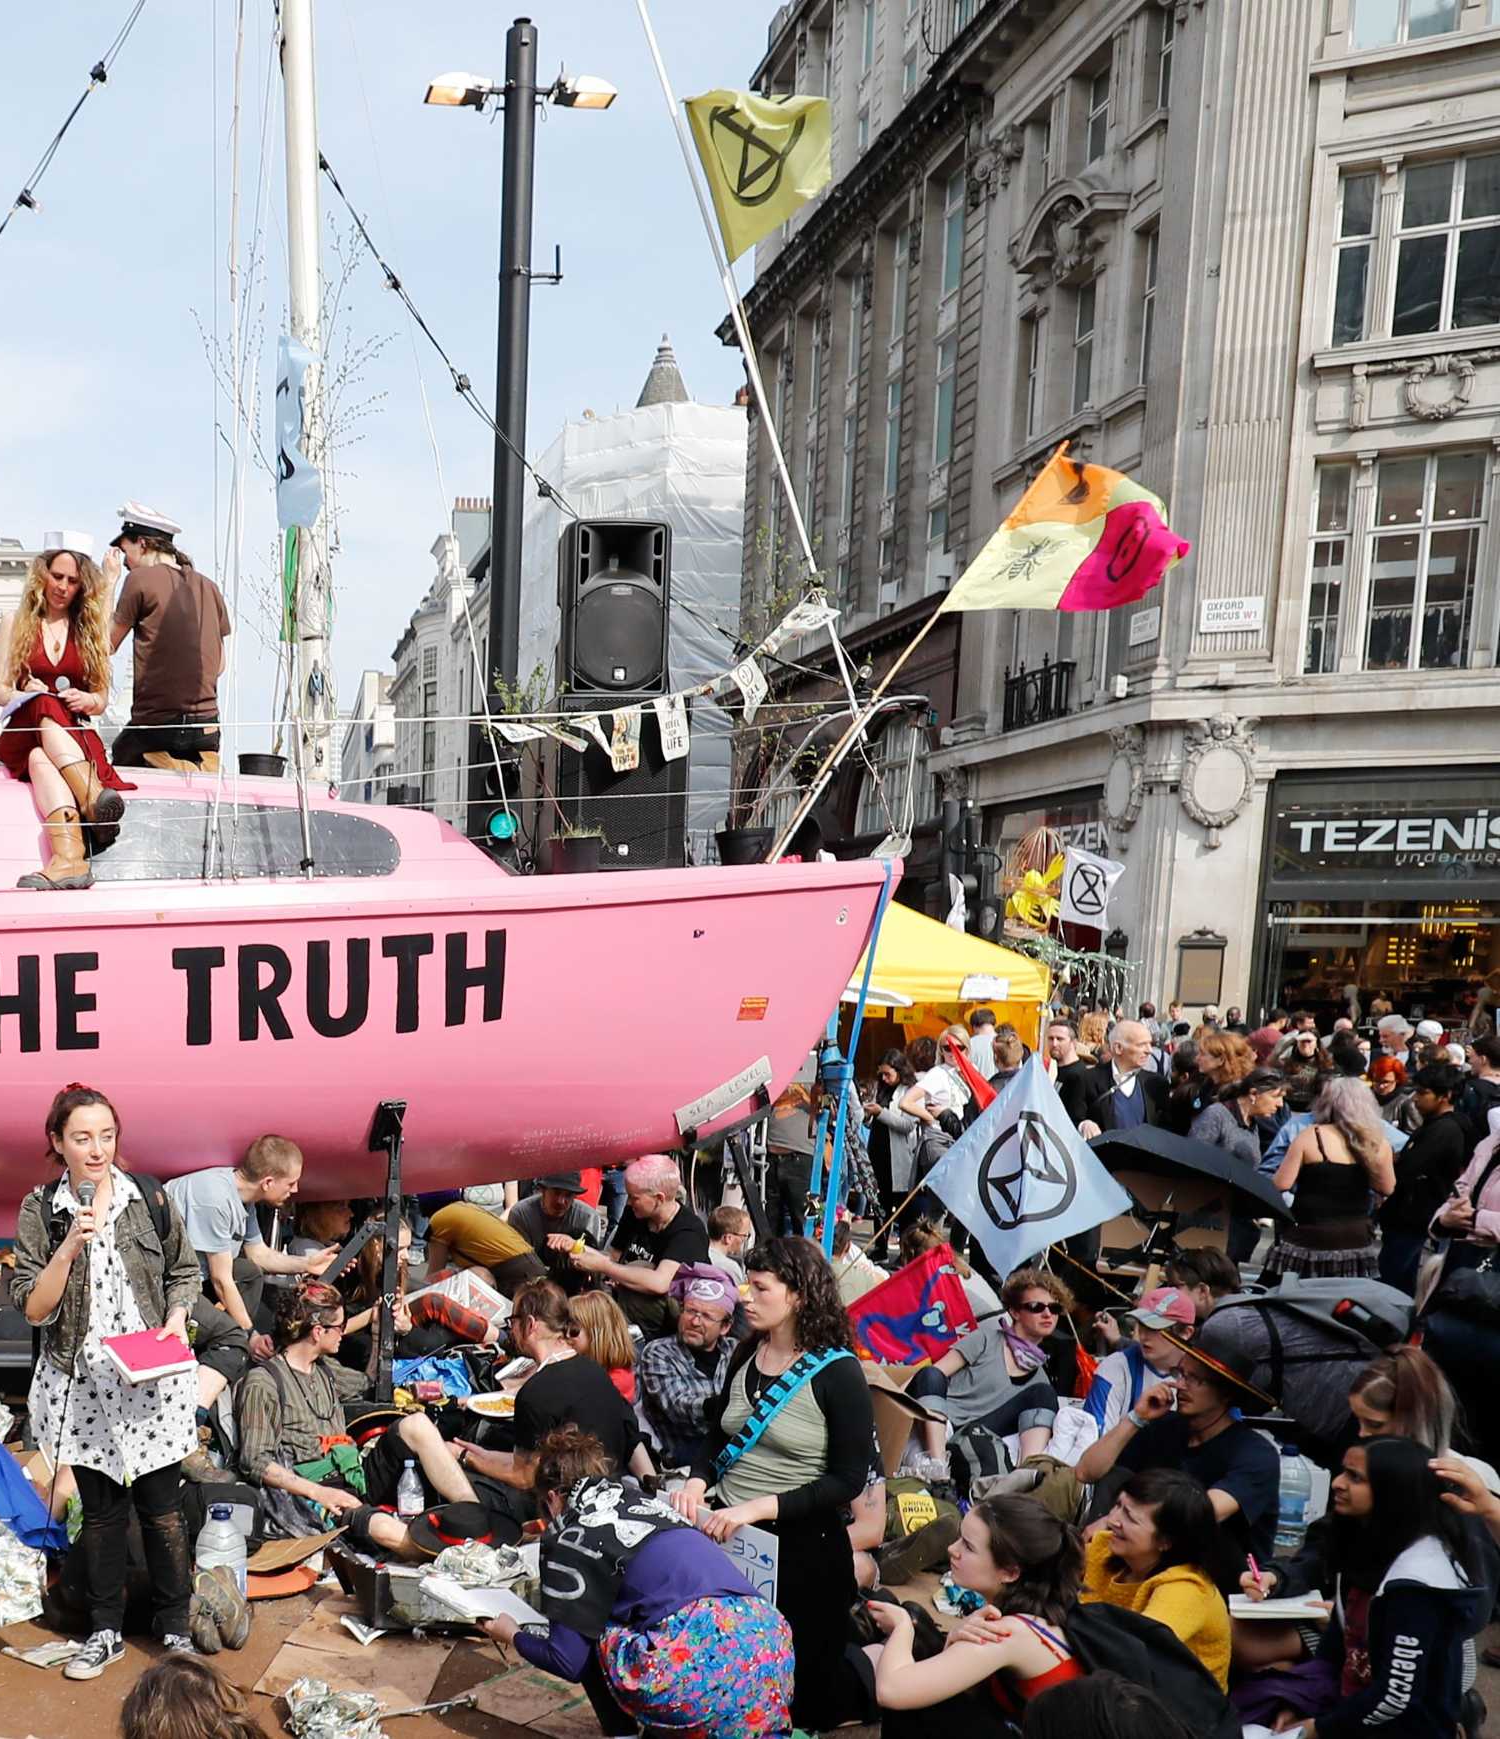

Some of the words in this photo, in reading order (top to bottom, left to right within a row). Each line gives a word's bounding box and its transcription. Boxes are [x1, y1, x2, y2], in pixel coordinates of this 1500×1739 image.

[1206, 600, 1245, 611] OXFORD
[1205, 611, 1241, 621] CIRCUS
[1243, 610, 1258, 620] W1
[666, 736, 684, 751] LIFE
[1051, 820, 1109, 850] EZEN
[1395, 851, 1500, 865] underwe
[172, 929, 507, 1046] TRUTH
[1362, 1634, 1424, 1726] abercro
